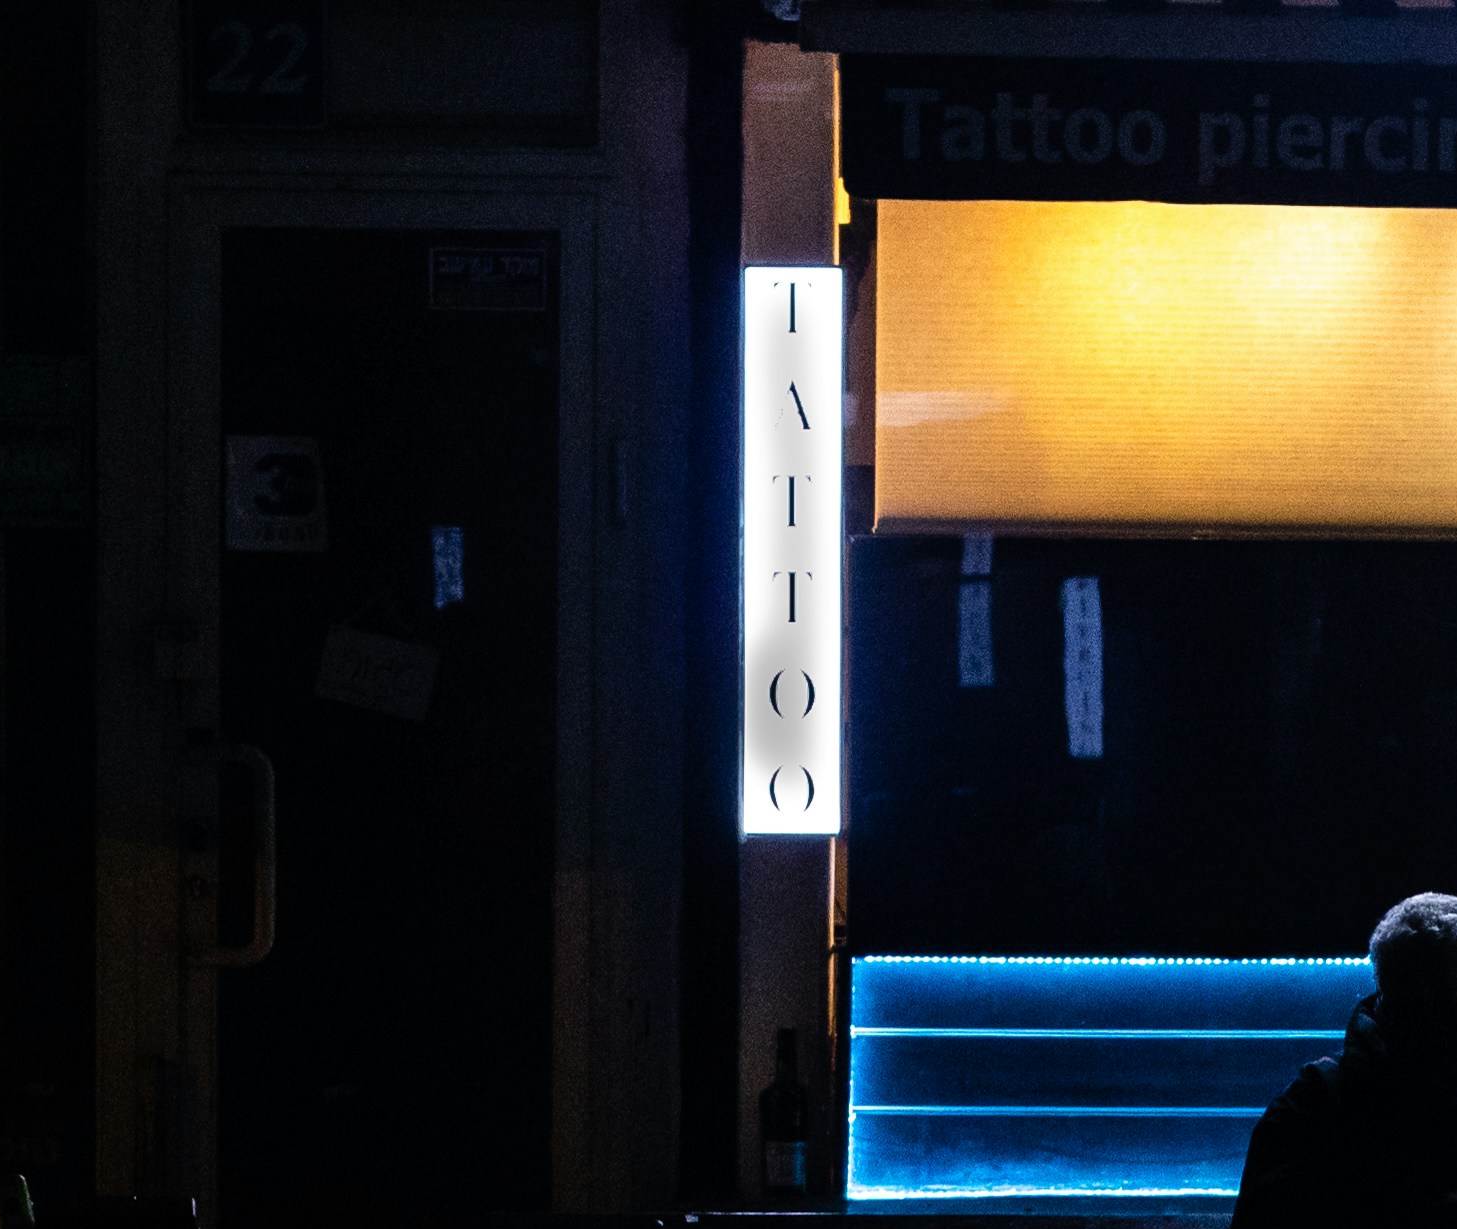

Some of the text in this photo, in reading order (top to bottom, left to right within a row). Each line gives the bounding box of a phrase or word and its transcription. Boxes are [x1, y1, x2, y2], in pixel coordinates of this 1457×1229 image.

[207, 17, 310, 96] 22
[884, 87, 1168, 165] Tattoo
[769, 281, 815, 812] TATTOO
